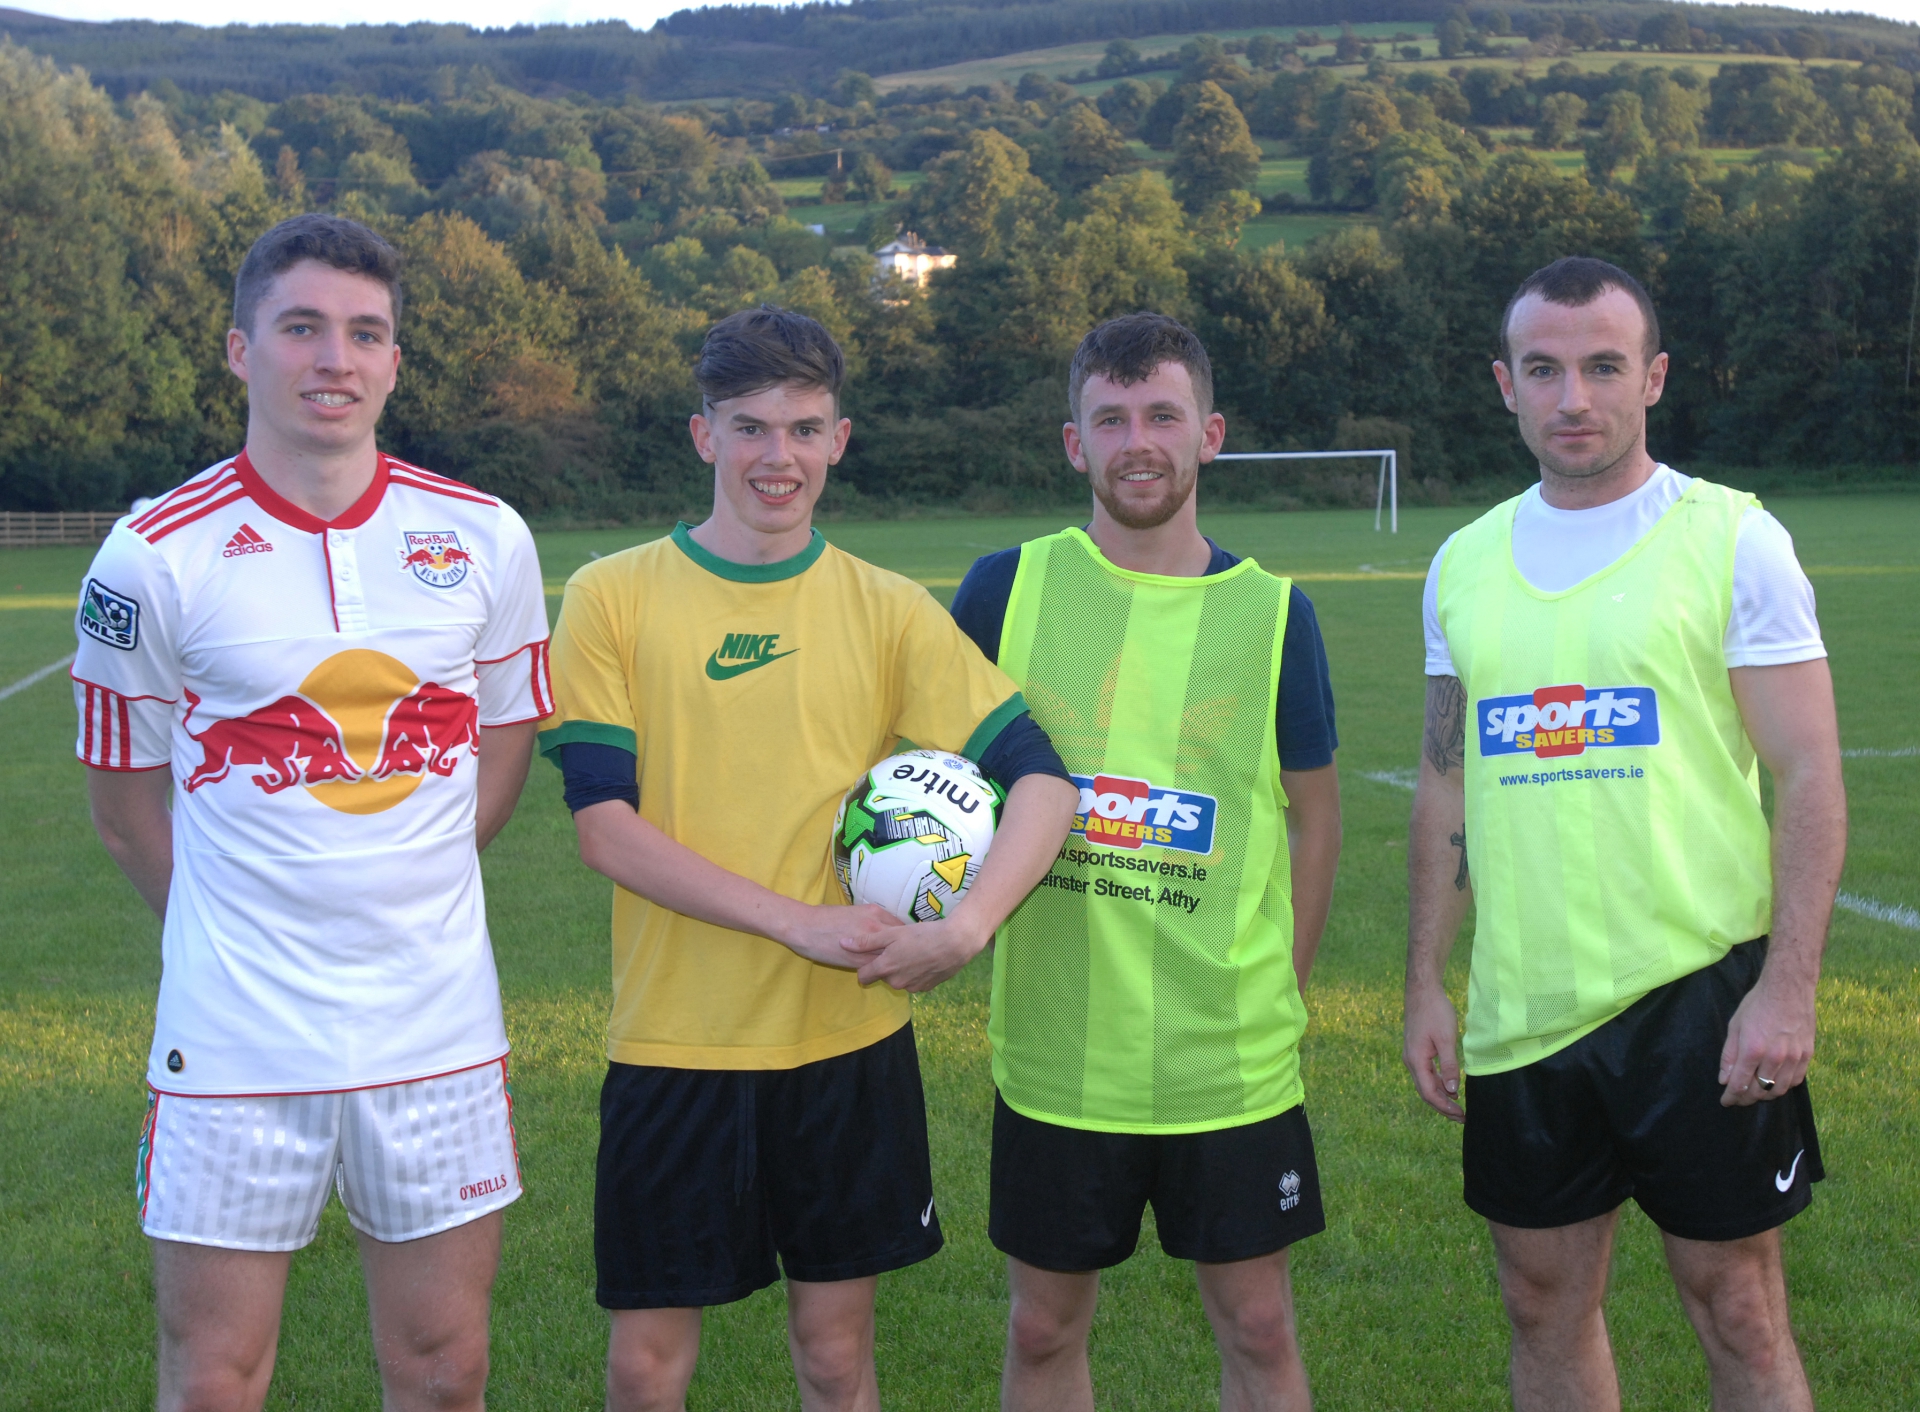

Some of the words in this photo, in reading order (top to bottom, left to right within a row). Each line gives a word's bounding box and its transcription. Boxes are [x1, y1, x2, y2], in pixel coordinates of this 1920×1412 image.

[222, 542, 273, 558] adidas
[420, 567, 438, 583] NEW
[442, 565, 463, 584] YORK
[83, 615, 131, 645] MLS
[718, 633, 780, 660] NIKE
[1485, 691, 1641, 742] sports
[1515, 728, 1615, 749] SAVERS
[892, 764, 980, 814] mitre
[1499, 765, 1645, 786] www.sportssavers.ie
[1071, 815, 1172, 843] SAVERS
[1040, 869, 1090, 894] einster
[1094, 878, 1154, 905] Street,
[1157, 886, 1200, 913] Athy
[459, 1174, 507, 1201] O'NEILLS
